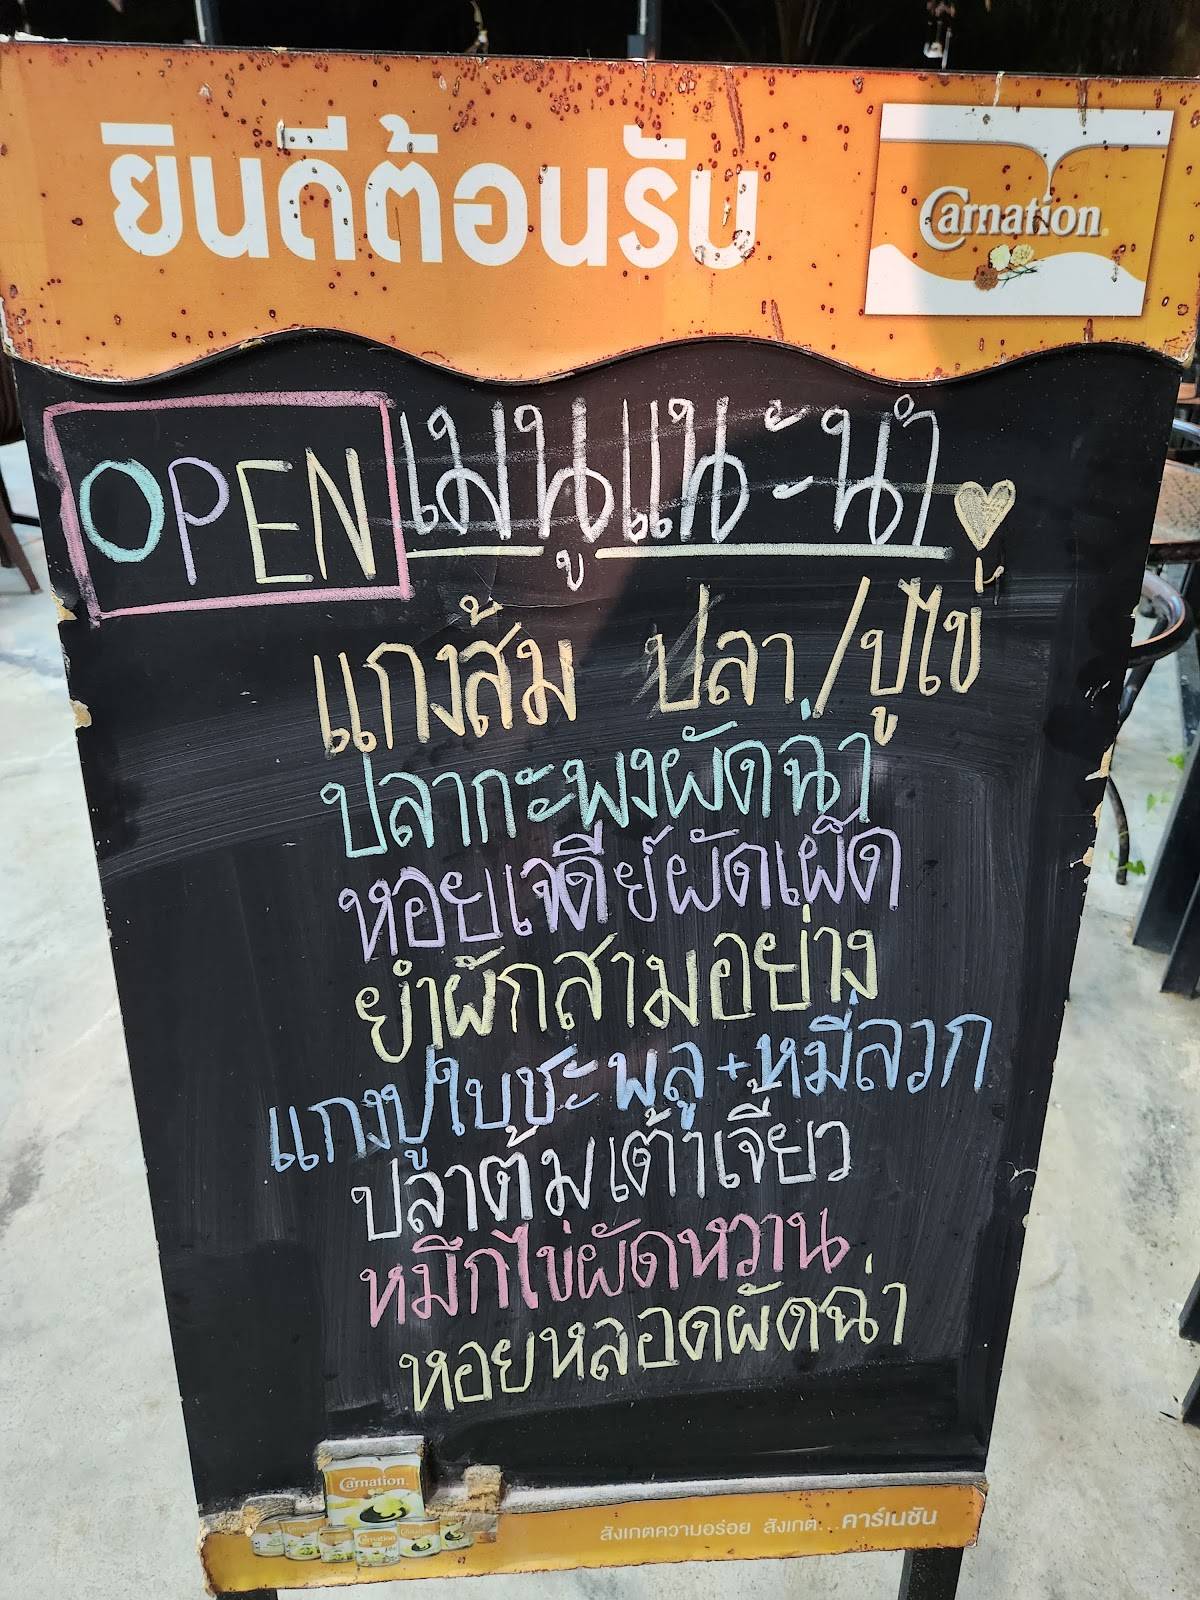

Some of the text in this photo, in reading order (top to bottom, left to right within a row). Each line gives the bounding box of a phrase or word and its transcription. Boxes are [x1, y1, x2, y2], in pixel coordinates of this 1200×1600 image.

[101, 113, 758, 269] ยินดีต้อนรับ
[918, 184, 1103, 251] Carnation
[80, 446, 377, 586] OPEN
[400, 393, 940, 592] เมนูแนะนำ
[313, 593, 577, 754] แกงส้ม
[320, 697, 871, 858] ปลากะพงผัดฉ่า
[355, 903, 878, 1064] ยำผักสามอย่าง
[360, 1207, 851, 1328] หมึกไข่ผัดหวาน
[398, 1253, 908, 1413] หอยหลอดผัดฉ่า
[339, 1475, 405, 1493] Carnation
[600, 1519, 751, 1542] สังเกตความอร่อย
